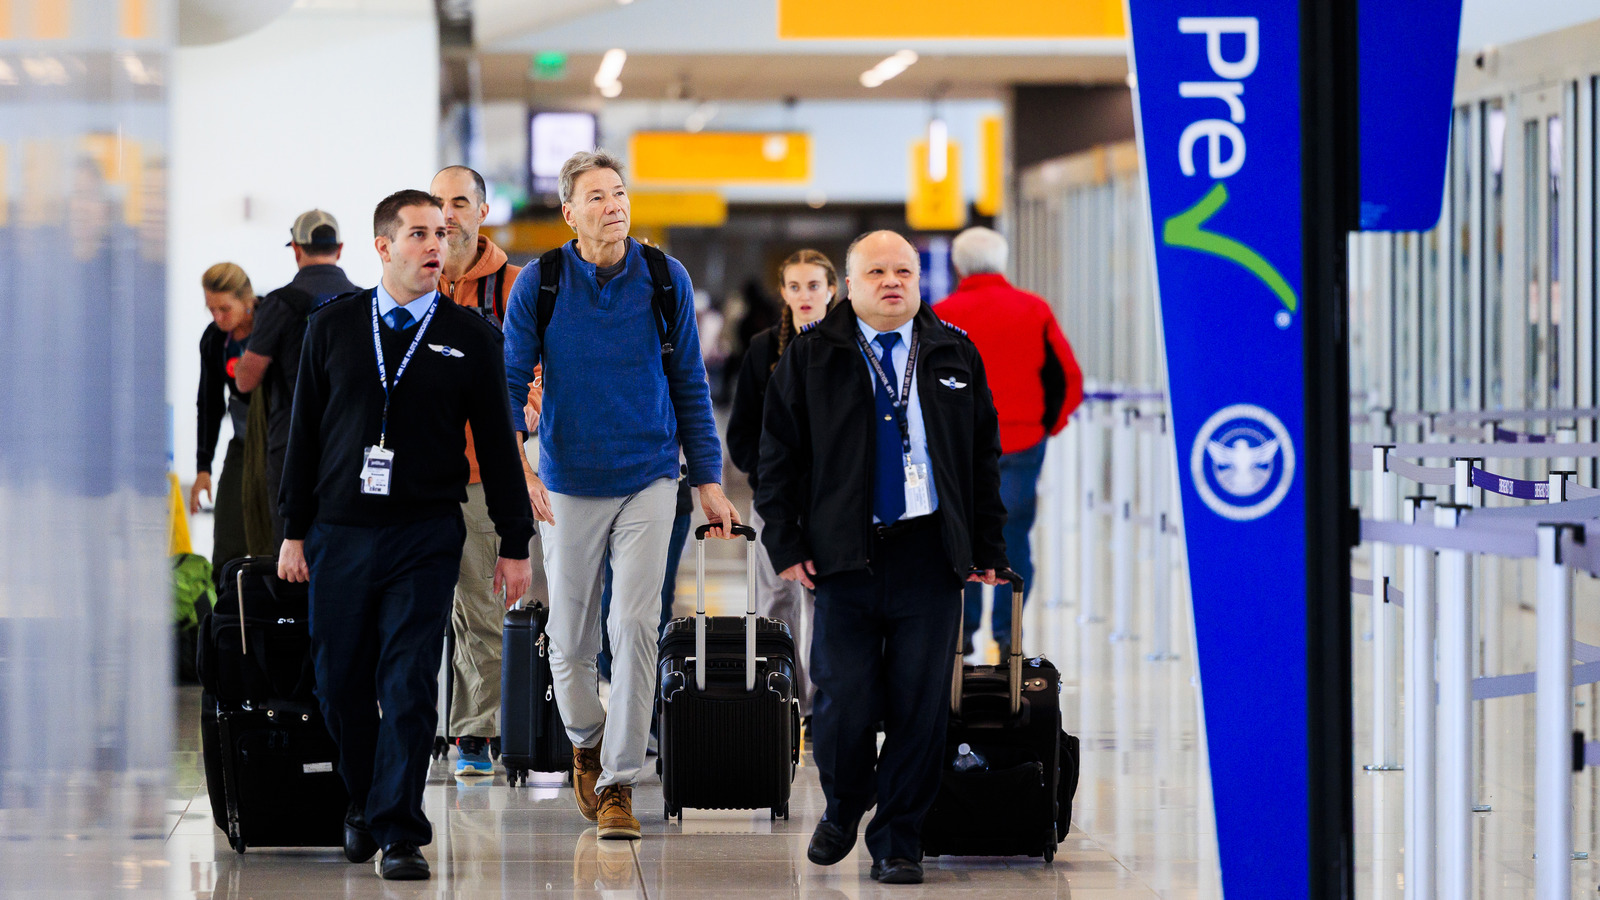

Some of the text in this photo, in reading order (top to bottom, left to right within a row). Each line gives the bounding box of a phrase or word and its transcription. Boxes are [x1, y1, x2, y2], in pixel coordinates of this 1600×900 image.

[1178, 17, 1259, 178] Pre
[400, 356, 409, 368] LINE
[405, 340, 418, 357] PILOTS
[862, 341, 874, 357] PILOTS
